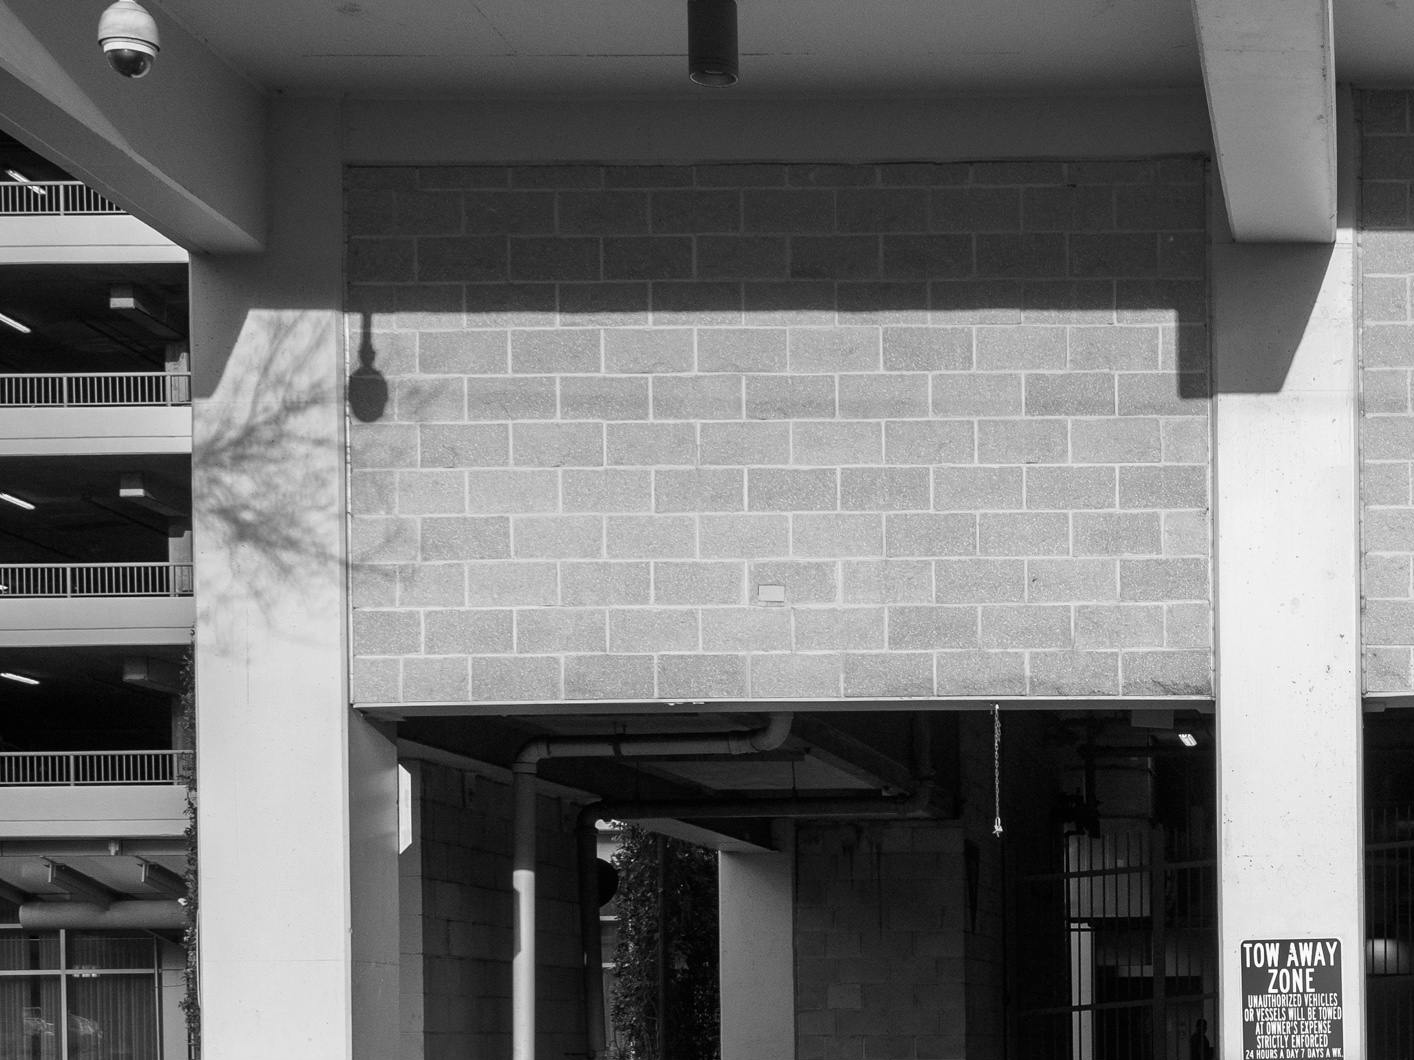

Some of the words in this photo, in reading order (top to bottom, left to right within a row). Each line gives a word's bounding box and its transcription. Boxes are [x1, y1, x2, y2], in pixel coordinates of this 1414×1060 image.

[1243, 943, 1279, 967] TOW
[1287, 942, 1337, 967] AWAY
[1268, 968, 1315, 993] ZONE
[1248, 994, 1301, 1008] UNAUTHORIZED
[1304, 993, 1337, 1006] VEHICLES
[1244, 1008, 1254, 1021] OR
[1256, 1008, 1286, 1021] VESSELS
[1288, 1008, 1305, 1020] WILL
[1308, 1007, 1316, 1020] BE
[1319, 1007, 1342, 1020] TOWED
[1256, 1022, 1263, 1035] AT
[1266, 1021, 1298, 1034] OWNER'S
[1300, 1021, 1331, 1034] EXPENSE
[1257, 1035, 1288, 1048] STRICTLY
[1292, 1034, 1328, 1047] ENFORCED
[1246, 1050, 1254, 1060] 24
[1257, 1049, 1277, 1059] HOURS
[1280, 1049, 1284, 1059] A
[1286, 1049, 1299, 1058] DAY
[1301, 1048, 1304, 1058] 7
[1308, 1048, 1324, 1058] DAYS
[1326, 1048, 1330, 1058] A
[1332, 1048, 1343, 1058] WK.
